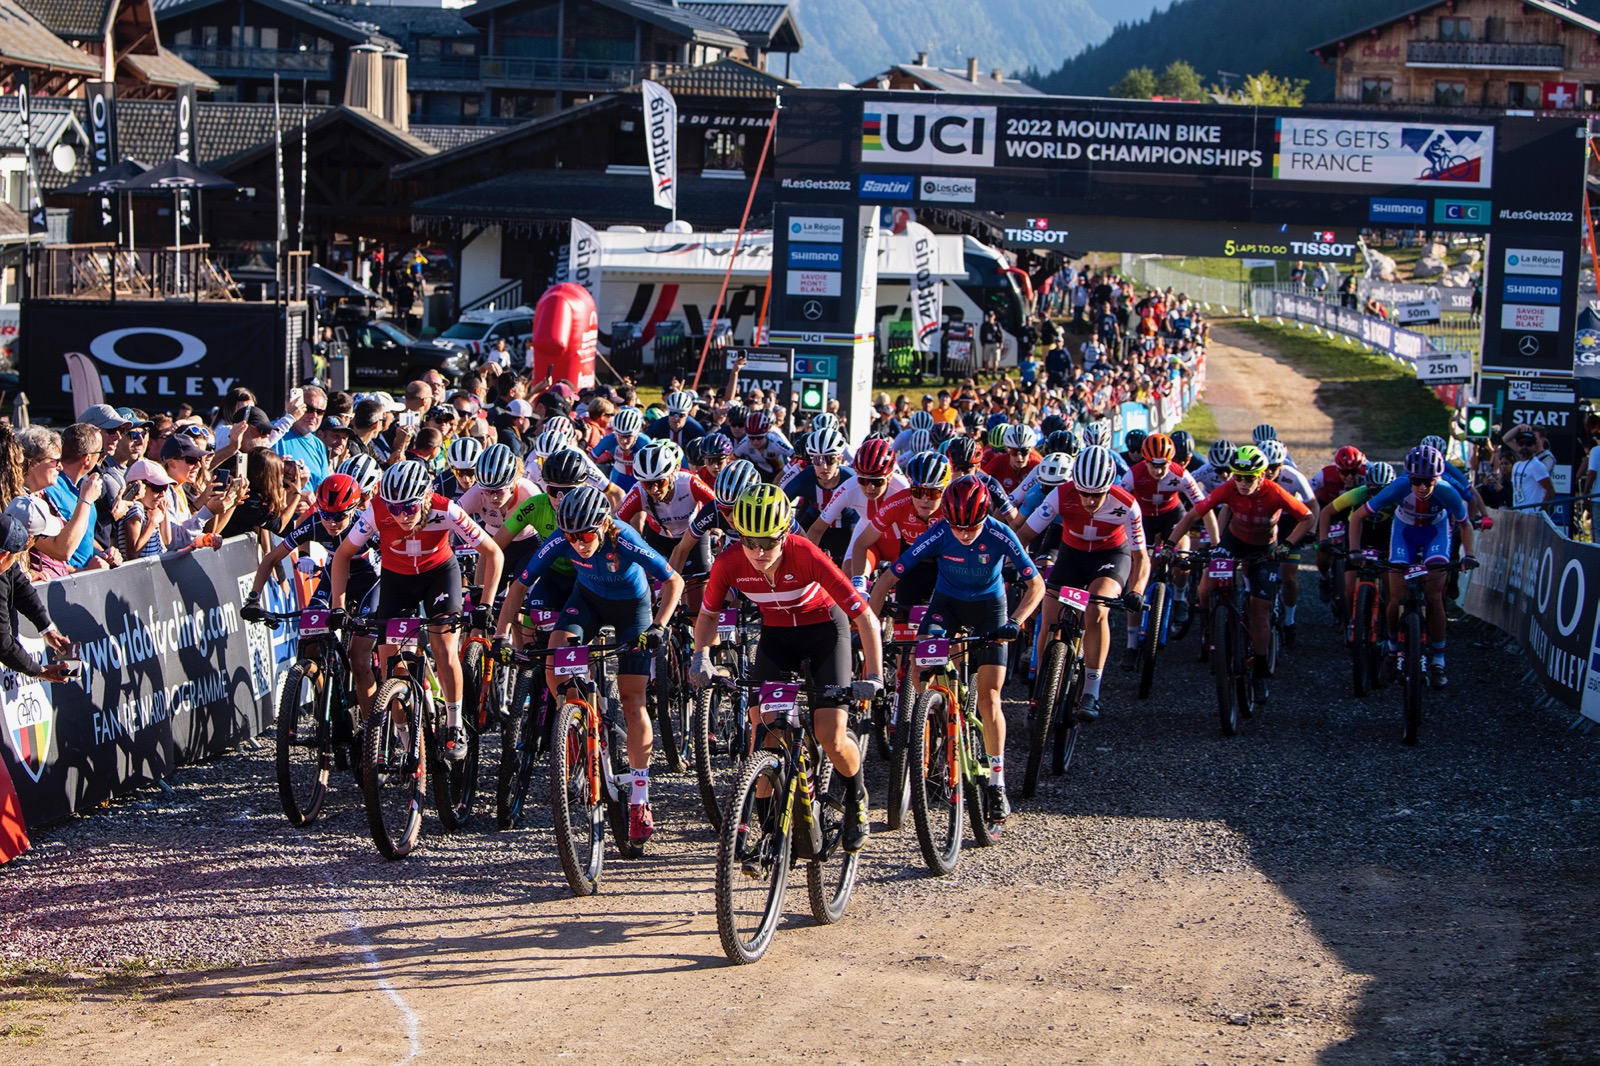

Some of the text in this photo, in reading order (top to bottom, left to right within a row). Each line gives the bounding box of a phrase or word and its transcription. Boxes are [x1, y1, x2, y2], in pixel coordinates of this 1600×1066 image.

[690, 115, 709, 124] DU
[713, 116, 736, 125] SKI
[886, 114, 985, 155] UCI
[1006, 118, 1221, 143] 2022 MOUNTAIN BIKE
[1292, 128, 1389, 149] LES GETS
[1005, 140, 1263, 167] WORLD CHAMPIONSHIPS
[1291, 152, 1373, 172] FRANCE
[782, 178, 851, 190] #LesGets2022
[862, 180, 911, 193] Santini
[936, 184, 952, 194] Les
[952, 184, 973, 195] Gets
[1373, 203, 1424, 215] SHIMANO
[1499, 209, 1574, 221] #LesGets2022
[814, 222, 841, 232] Région
[1005, 228, 1068, 243] TISSOT
[1224, 240, 1287, 256] 5 LAPS TO GO
[1290, 241, 1355, 256] TISSOT
[791, 252, 839, 262] SHIMANO
[1521, 255, 1560, 265] La Région
[1507, 285, 1558, 295] SHIMANO
[1407, 309, 1430, 318] 50m
[803, 334, 821, 343] UCI
[1429, 363, 1458, 374] 25m
[1512, 382, 1530, 390] UCI
[1512, 408, 1570, 427] START
[291, 523, 311, 540] SKF
[1216, 561, 1227, 569] 12
[1068, 589, 1081, 600] 16
[310, 614, 319, 625] 9
[538, 611, 551, 621] 18
[398, 621, 408, 633] 5
[80, 601, 238, 693] yworldofcycling.com
[927, 643, 937, 654] 8
[566, 651, 577, 662] 4
[4, 675, 15, 691] OF
[772, 687, 783, 699] 6
[93, 709, 122, 745] FAN
[123, 688, 167, 735] REWARD
